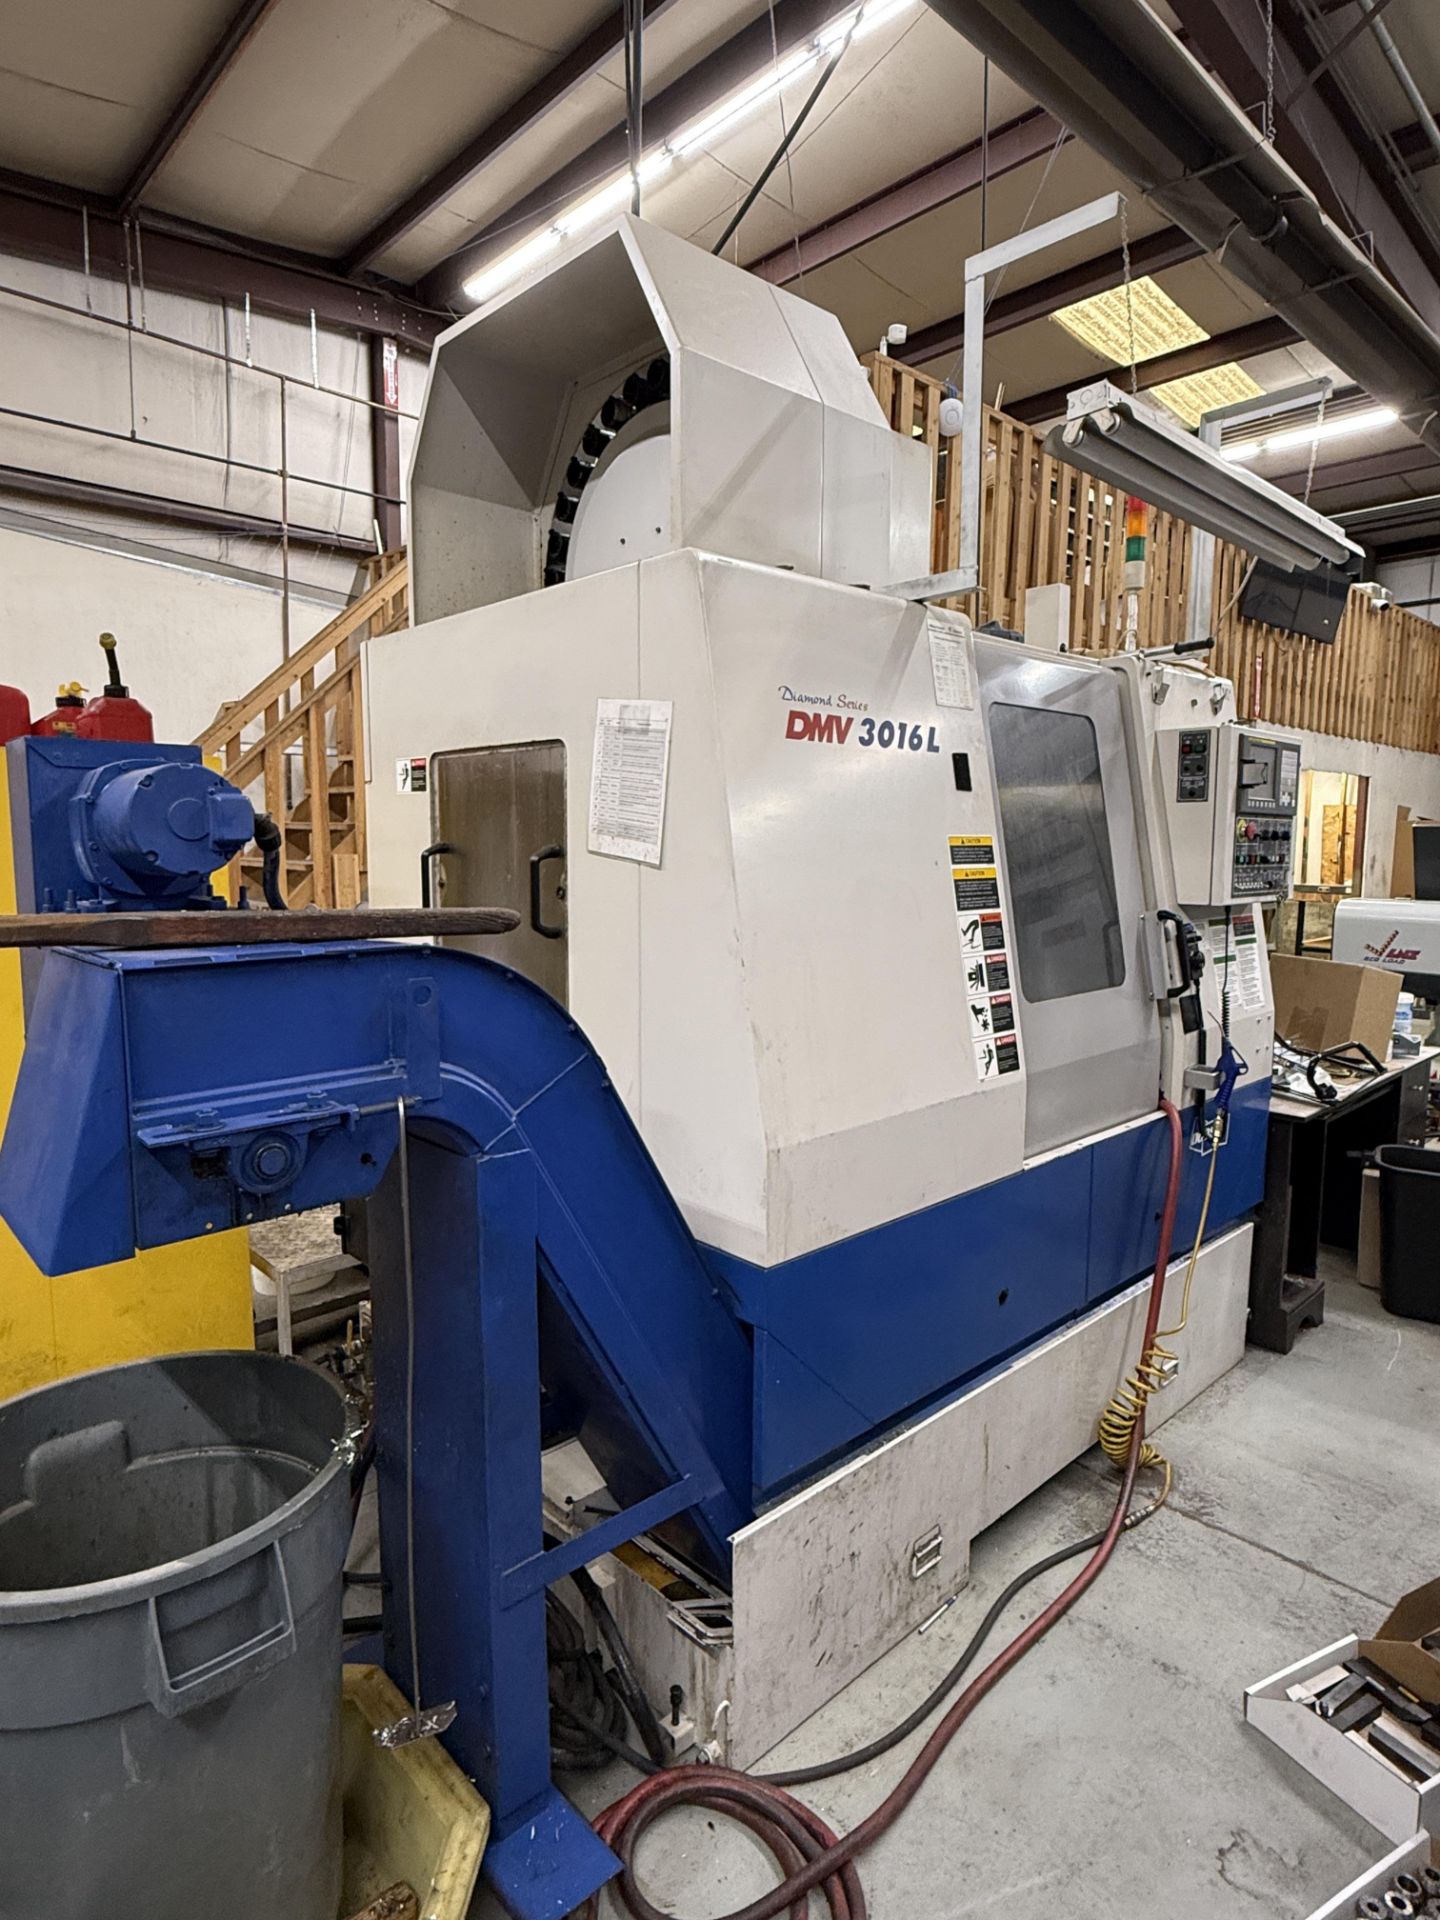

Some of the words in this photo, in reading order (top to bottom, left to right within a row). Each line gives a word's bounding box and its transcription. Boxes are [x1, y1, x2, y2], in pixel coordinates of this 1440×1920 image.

[778, 685, 832, 707] Diamond
[836, 694, 868, 711] Series
[785, 709, 854, 744] DMV
